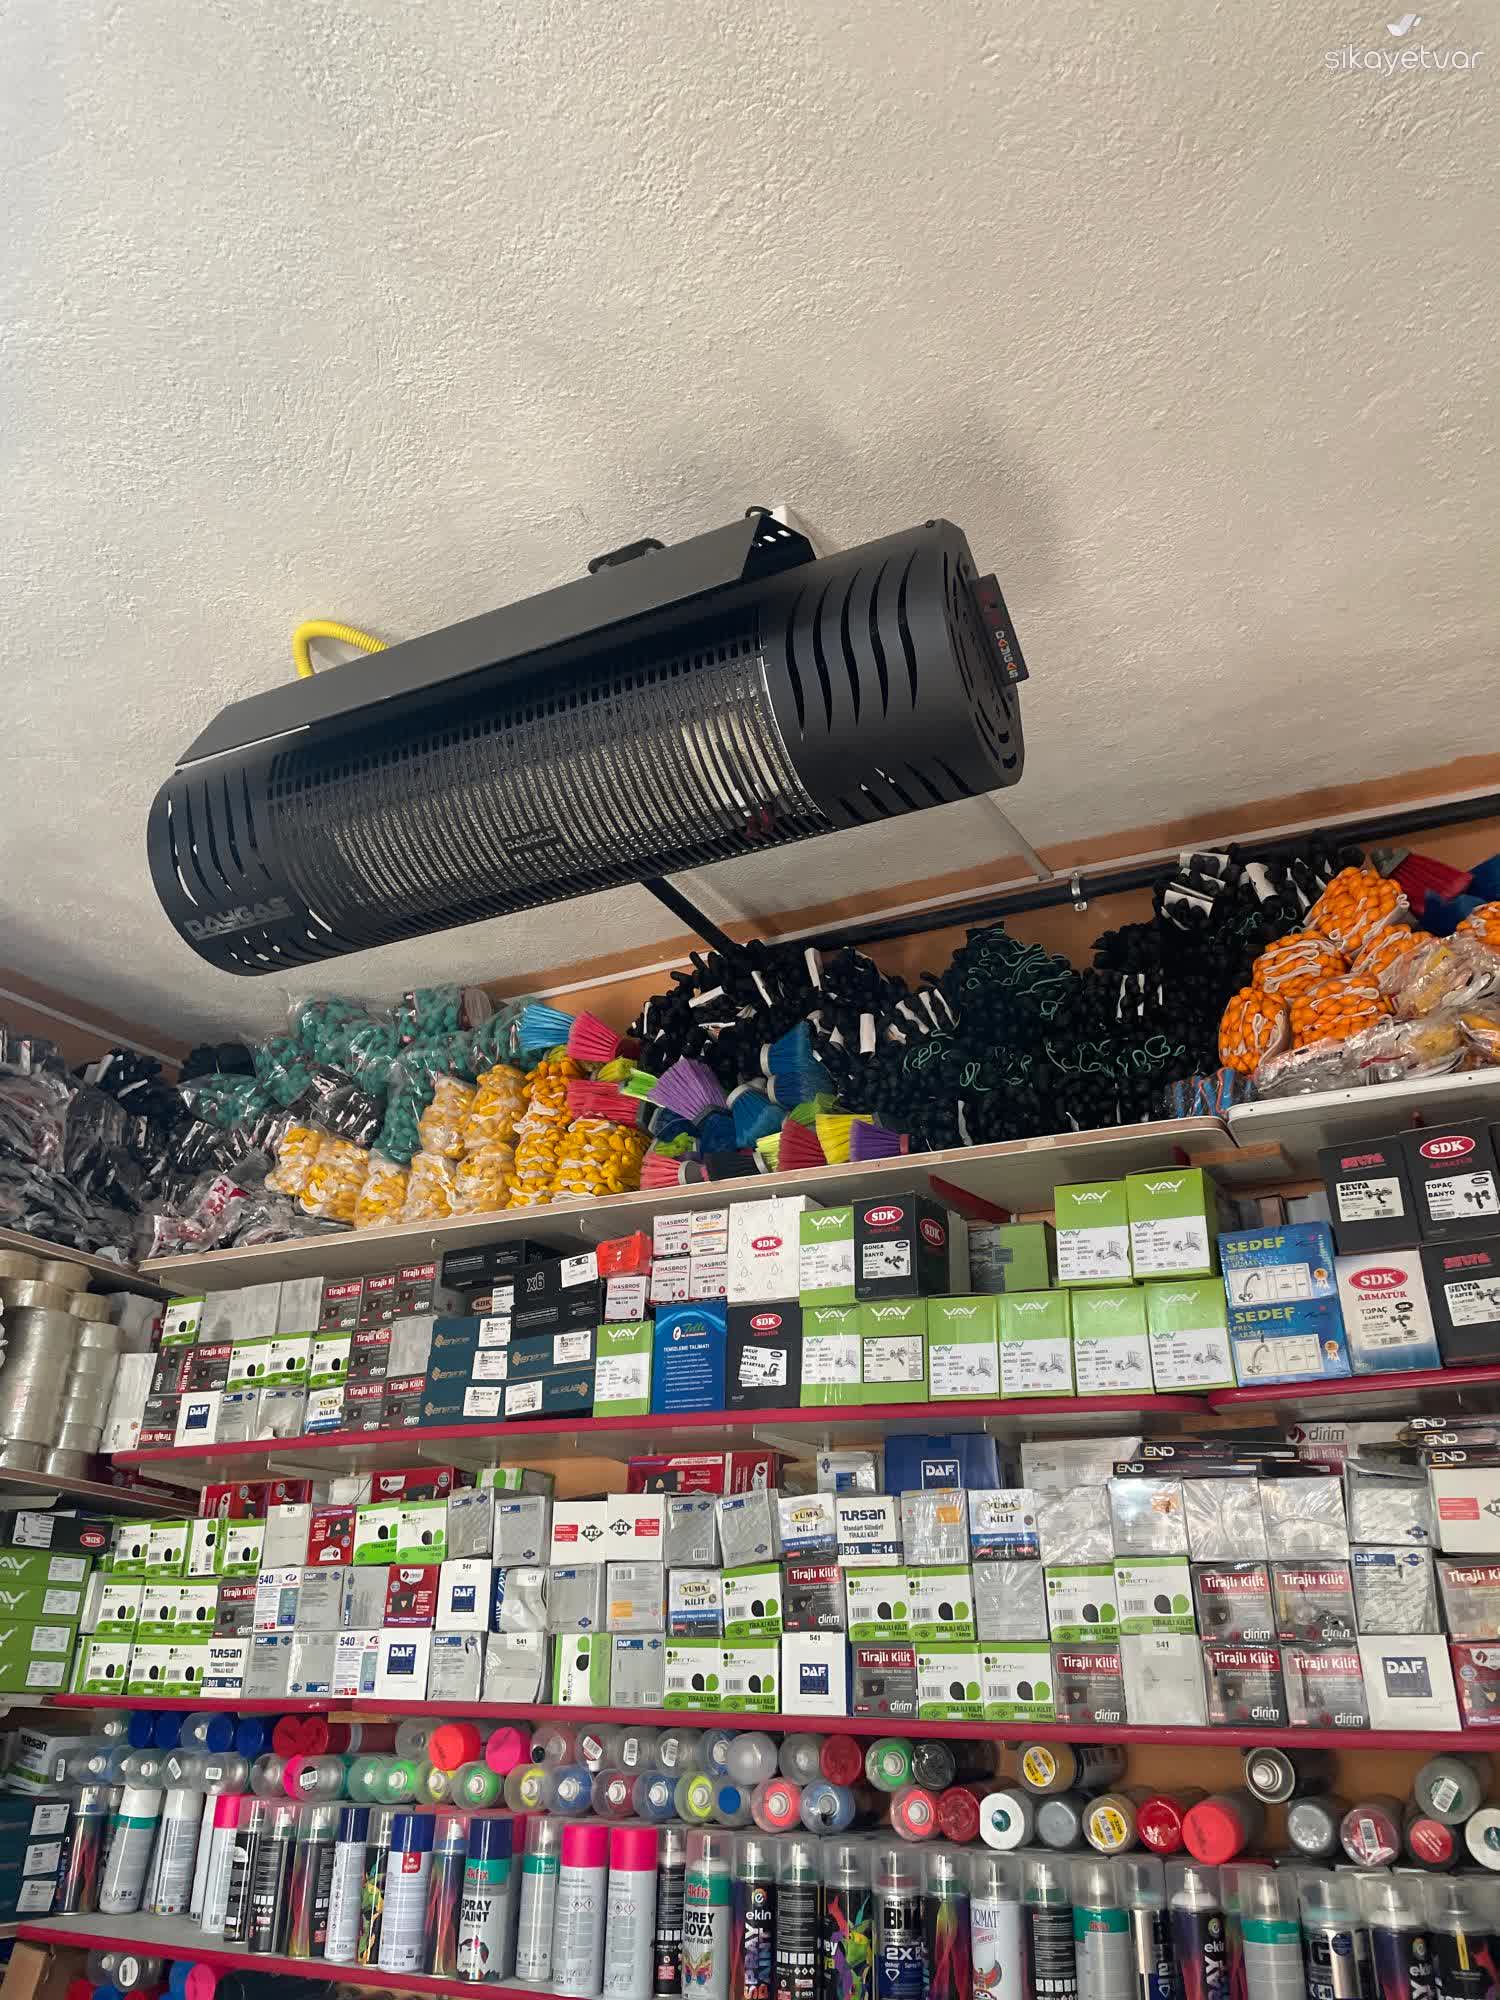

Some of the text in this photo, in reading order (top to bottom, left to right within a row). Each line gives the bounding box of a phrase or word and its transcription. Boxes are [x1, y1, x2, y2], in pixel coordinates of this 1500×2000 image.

[1429, 1140, 1465, 1155] SDK
[1426, 1182, 1453, 1190] TOPAÇ
[1428, 1190, 1455, 1198] BANYO
[871, 1211, 896, 1222] SDK
[924, 1224, 941, 1241] SDK
[756, 1239, 777, 1249] SDK
[1226, 1236, 1286, 1254] SEDEF
[527, 1272, 545, 1292] x6
[1360, 1272, 1396, 1287] SDK
[1358, 1290, 1408, 1301] ARMATÜR
[1234, 1306, 1295, 1323] SEDEF
[756, 1317, 776, 1327] SDK
[189, 1405, 208, 1416] DAF
[1412, 1418, 1447, 1429] END
[1308, 1426, 1345, 1441] dirim
[1424, 1433, 1459, 1445] END
[1144, 1446, 1175, 1457] END
[1431, 1450, 1467, 1462] END
[926, 1464, 956, 1476] DAF
[1116, 1463, 1144, 1473] END
[795, 1511, 819, 1520] YUMA
[844, 1545, 861, 1555] 301
[883, 1545, 894, 1554] 14
[1356, 1553, 1376, 1562] DAF
[259, 1574, 274, 1585] 540
[792, 1566, 839, 1581] Tirajlı Kilit
[1282, 1573, 1345, 1586] Tirajlı Kilit
[1448, 1569, 1485, 1584] Tirajlı
[1205, 1575, 1265, 1590] Tirajlı Kilit
[453, 1587, 474, 1597] DAF
[683, 1585, 707, 1593] YUMA
[684, 1598, 706, 1606] KİLİT
[818, 1613, 840, 1625] dirim
[809, 1634, 821, 1642] 541
[1243, 1628, 1270, 1641] dirim
[340, 1637, 356, 1647] 540
[516, 1638, 527, 1646] 541
[1156, 1641, 1170, 1649] 541
[391, 1647, 414, 1657] DAF
[861, 1651, 912, 1663] Tirajlı Kilit
[1214, 1651, 1275, 1665] Tirajlı Kilit
[1062, 1656, 1119, 1669] Tirajlı Kilit
[1294, 1656, 1359, 1671] Tirajlı Kilit
[1386, 1660, 1424, 1674] DAF
[801, 1666, 826, 1677] DAF
[889, 1700, 913, 1712] dirim
[1094, 1709, 1120, 1721] dirim
[1251, 1706, 1280, 1719] dirim
[1334, 1713, 1364, 1726] dirim
[461, 1911, 490, 1922] PAINT
[745, 1909, 772, 1921] ekin
[684, 1923, 713, 1937] BOYA
[886, 1947, 913, 1961] 2X
